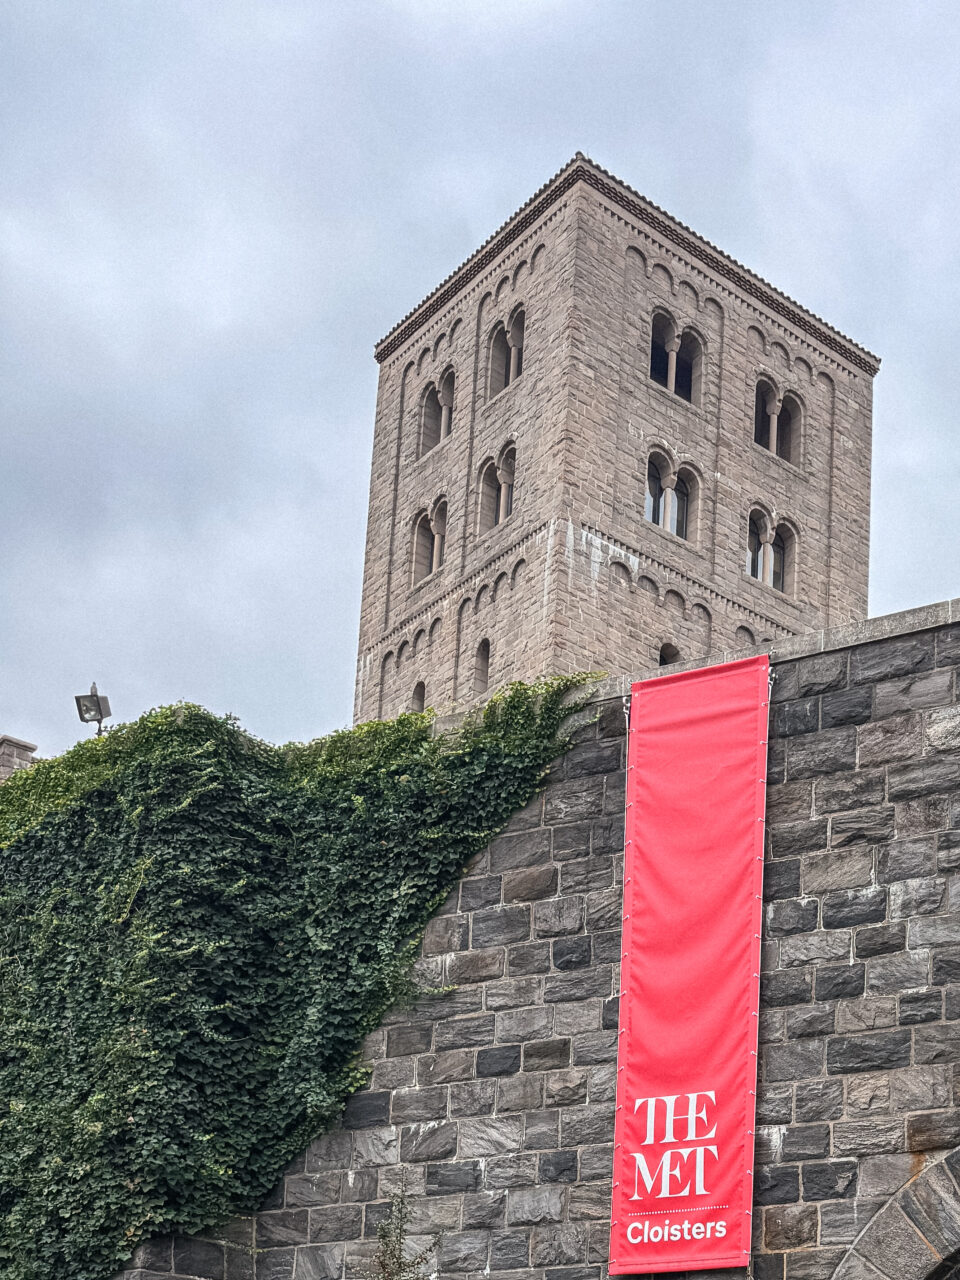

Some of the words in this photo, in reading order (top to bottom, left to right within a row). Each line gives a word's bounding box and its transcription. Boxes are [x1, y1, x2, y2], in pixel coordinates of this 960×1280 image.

[633, 1090, 718, 1146] THE
[628, 1145, 720, 1201] MET
[626, 1219, 728, 1244] Cloisters
